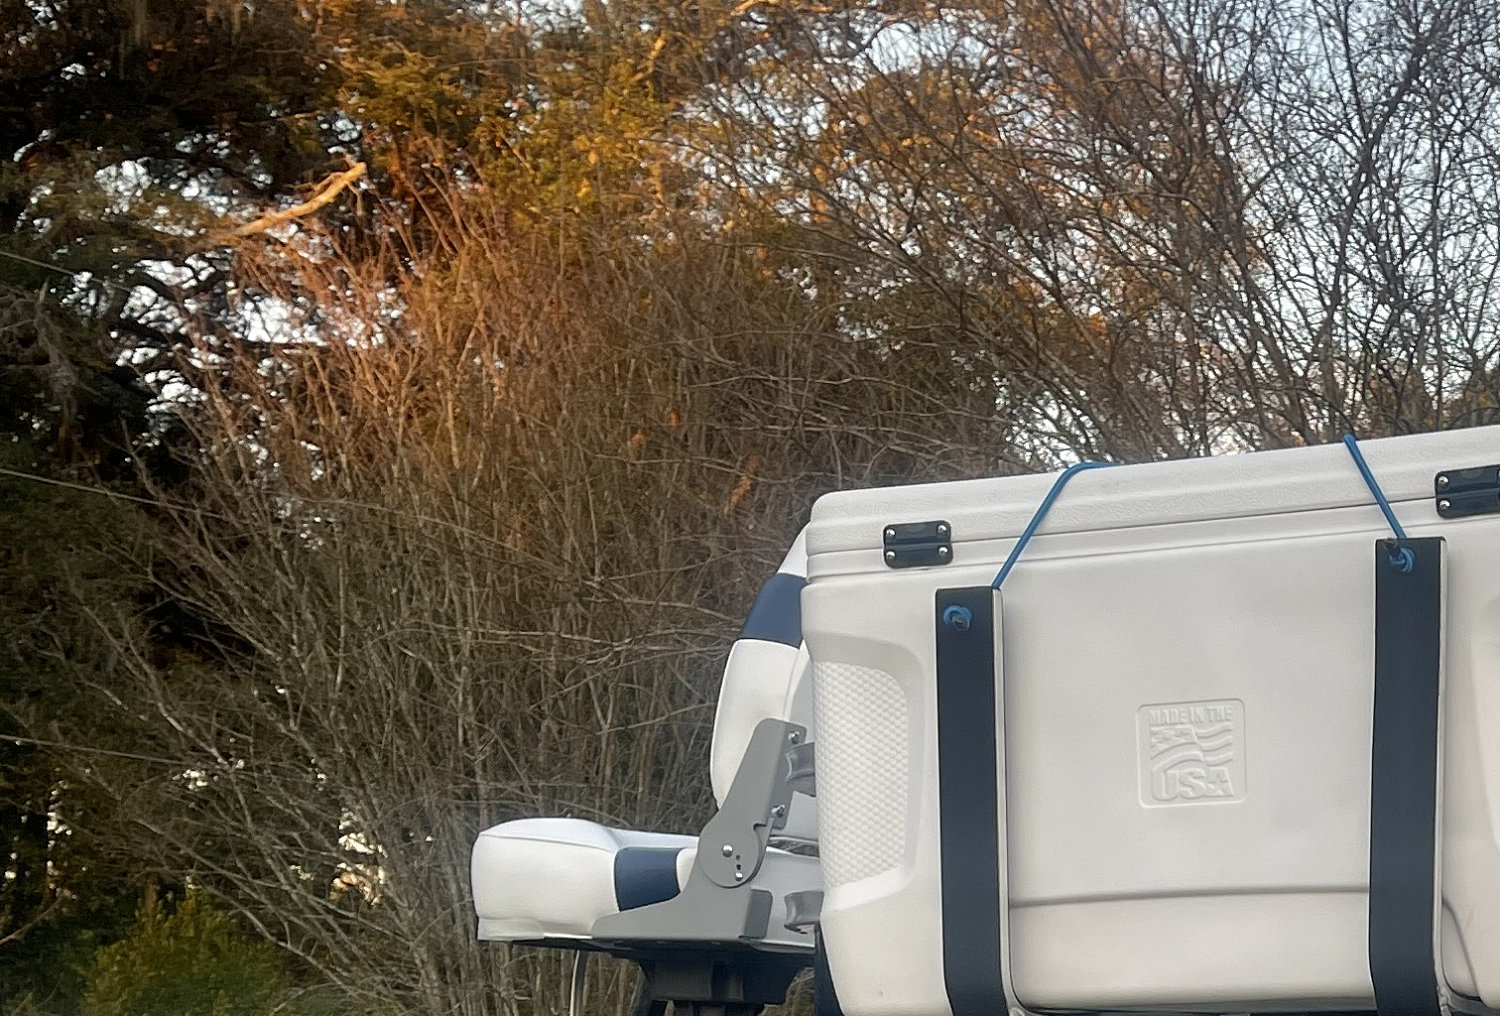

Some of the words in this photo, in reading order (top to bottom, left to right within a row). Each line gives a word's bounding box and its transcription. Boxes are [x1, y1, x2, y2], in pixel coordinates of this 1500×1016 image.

[1149, 707, 1187, 726] MADE
[1188, 706, 1205, 724] IN
[1205, 704, 1233, 722] THE
[1150, 766, 1234, 801] USA
